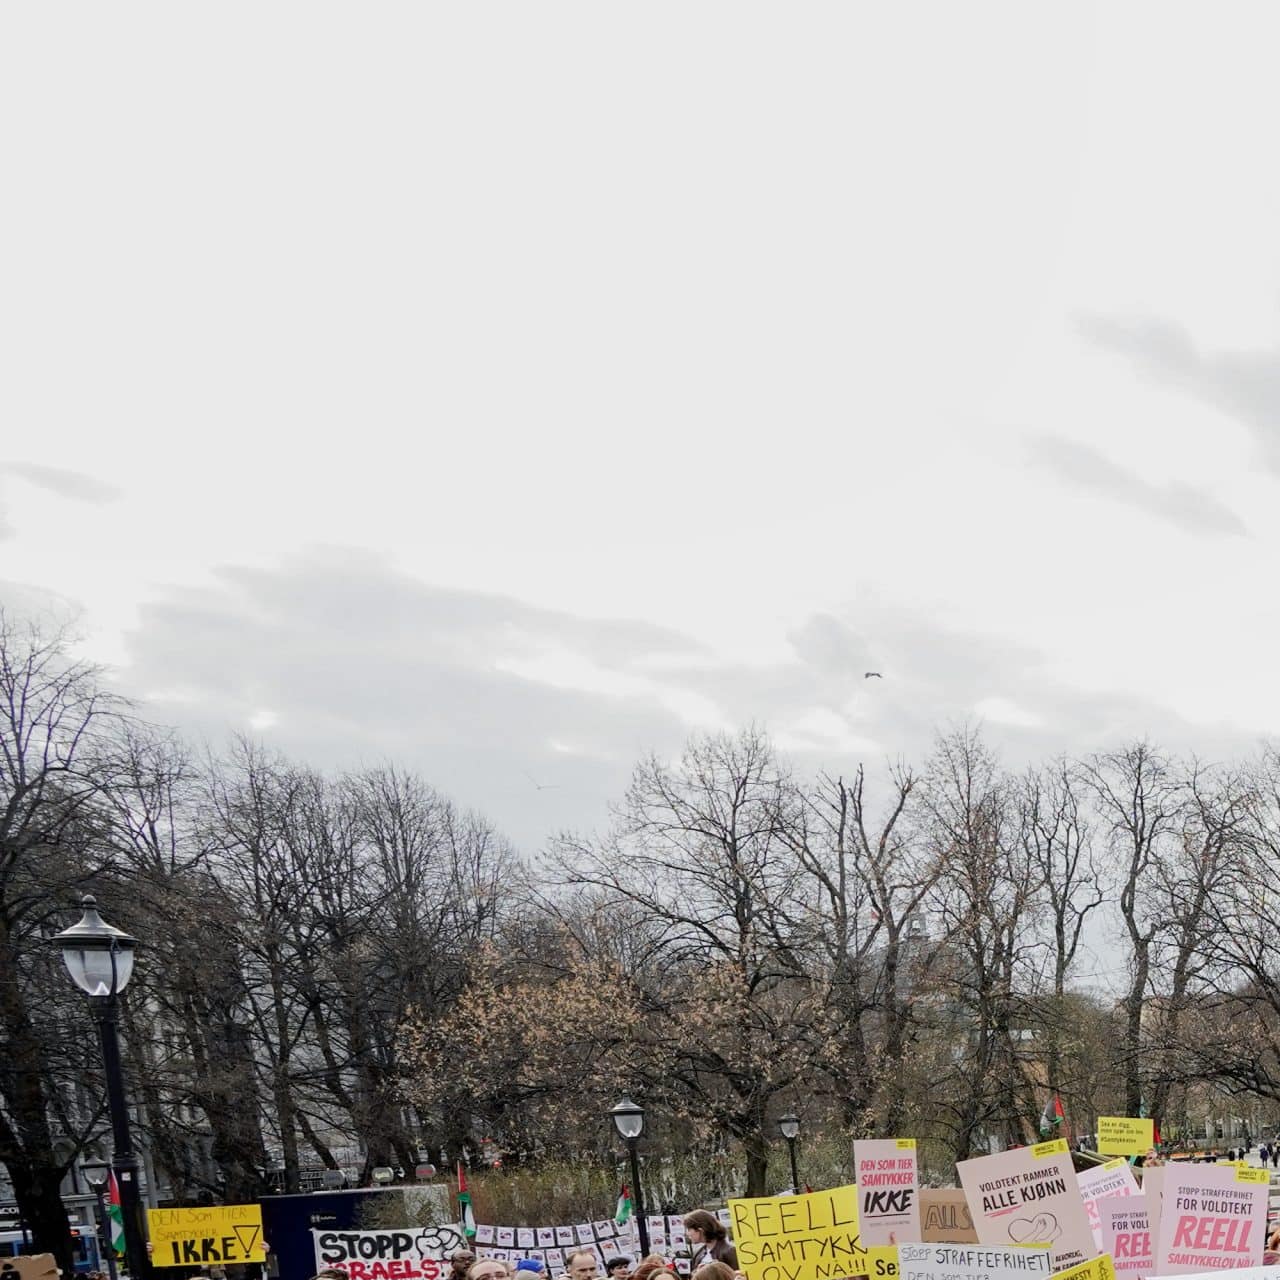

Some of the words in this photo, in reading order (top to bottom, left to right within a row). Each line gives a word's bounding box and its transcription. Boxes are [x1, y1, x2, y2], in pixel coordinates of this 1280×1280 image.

[860, 1160, 876, 1171] DEN
[877, 1159, 896, 1170] SOM
[898, 1158, 913, 1169] TIER
[861, 1172, 913, 1186] SAMTYKKER
[979, 1175, 1021, 1193] VOLDTEKT
[1023, 1166, 1060, 1182] RAMMER
[863, 1189, 914, 1214] IKKE
[983, 1191, 1018, 1212] ALLE
[1021, 1178, 1067, 1202] KJØNN
[1178, 1186, 1200, 1195] STOPP
[1201, 1188, 1253, 1200] STRAFFEFRIHET
[735, 1197, 855, 1238] REELL
[1176, 1198, 1198, 1211] FOR
[1201, 1199, 1253, 1215] VOLDTEKT
[1112, 1221, 1128, 1230] FOR
[1173, 1215, 1252, 1252] REELL
[320, 1232, 413, 1262] STOPP
[816, 1258, 866, 1279] NÅ!!!
[936, 1249, 1051, 1275] STRAFFEFRIHET!
[1168, 1253, 1235, 1268] SAMTYKKELOV
